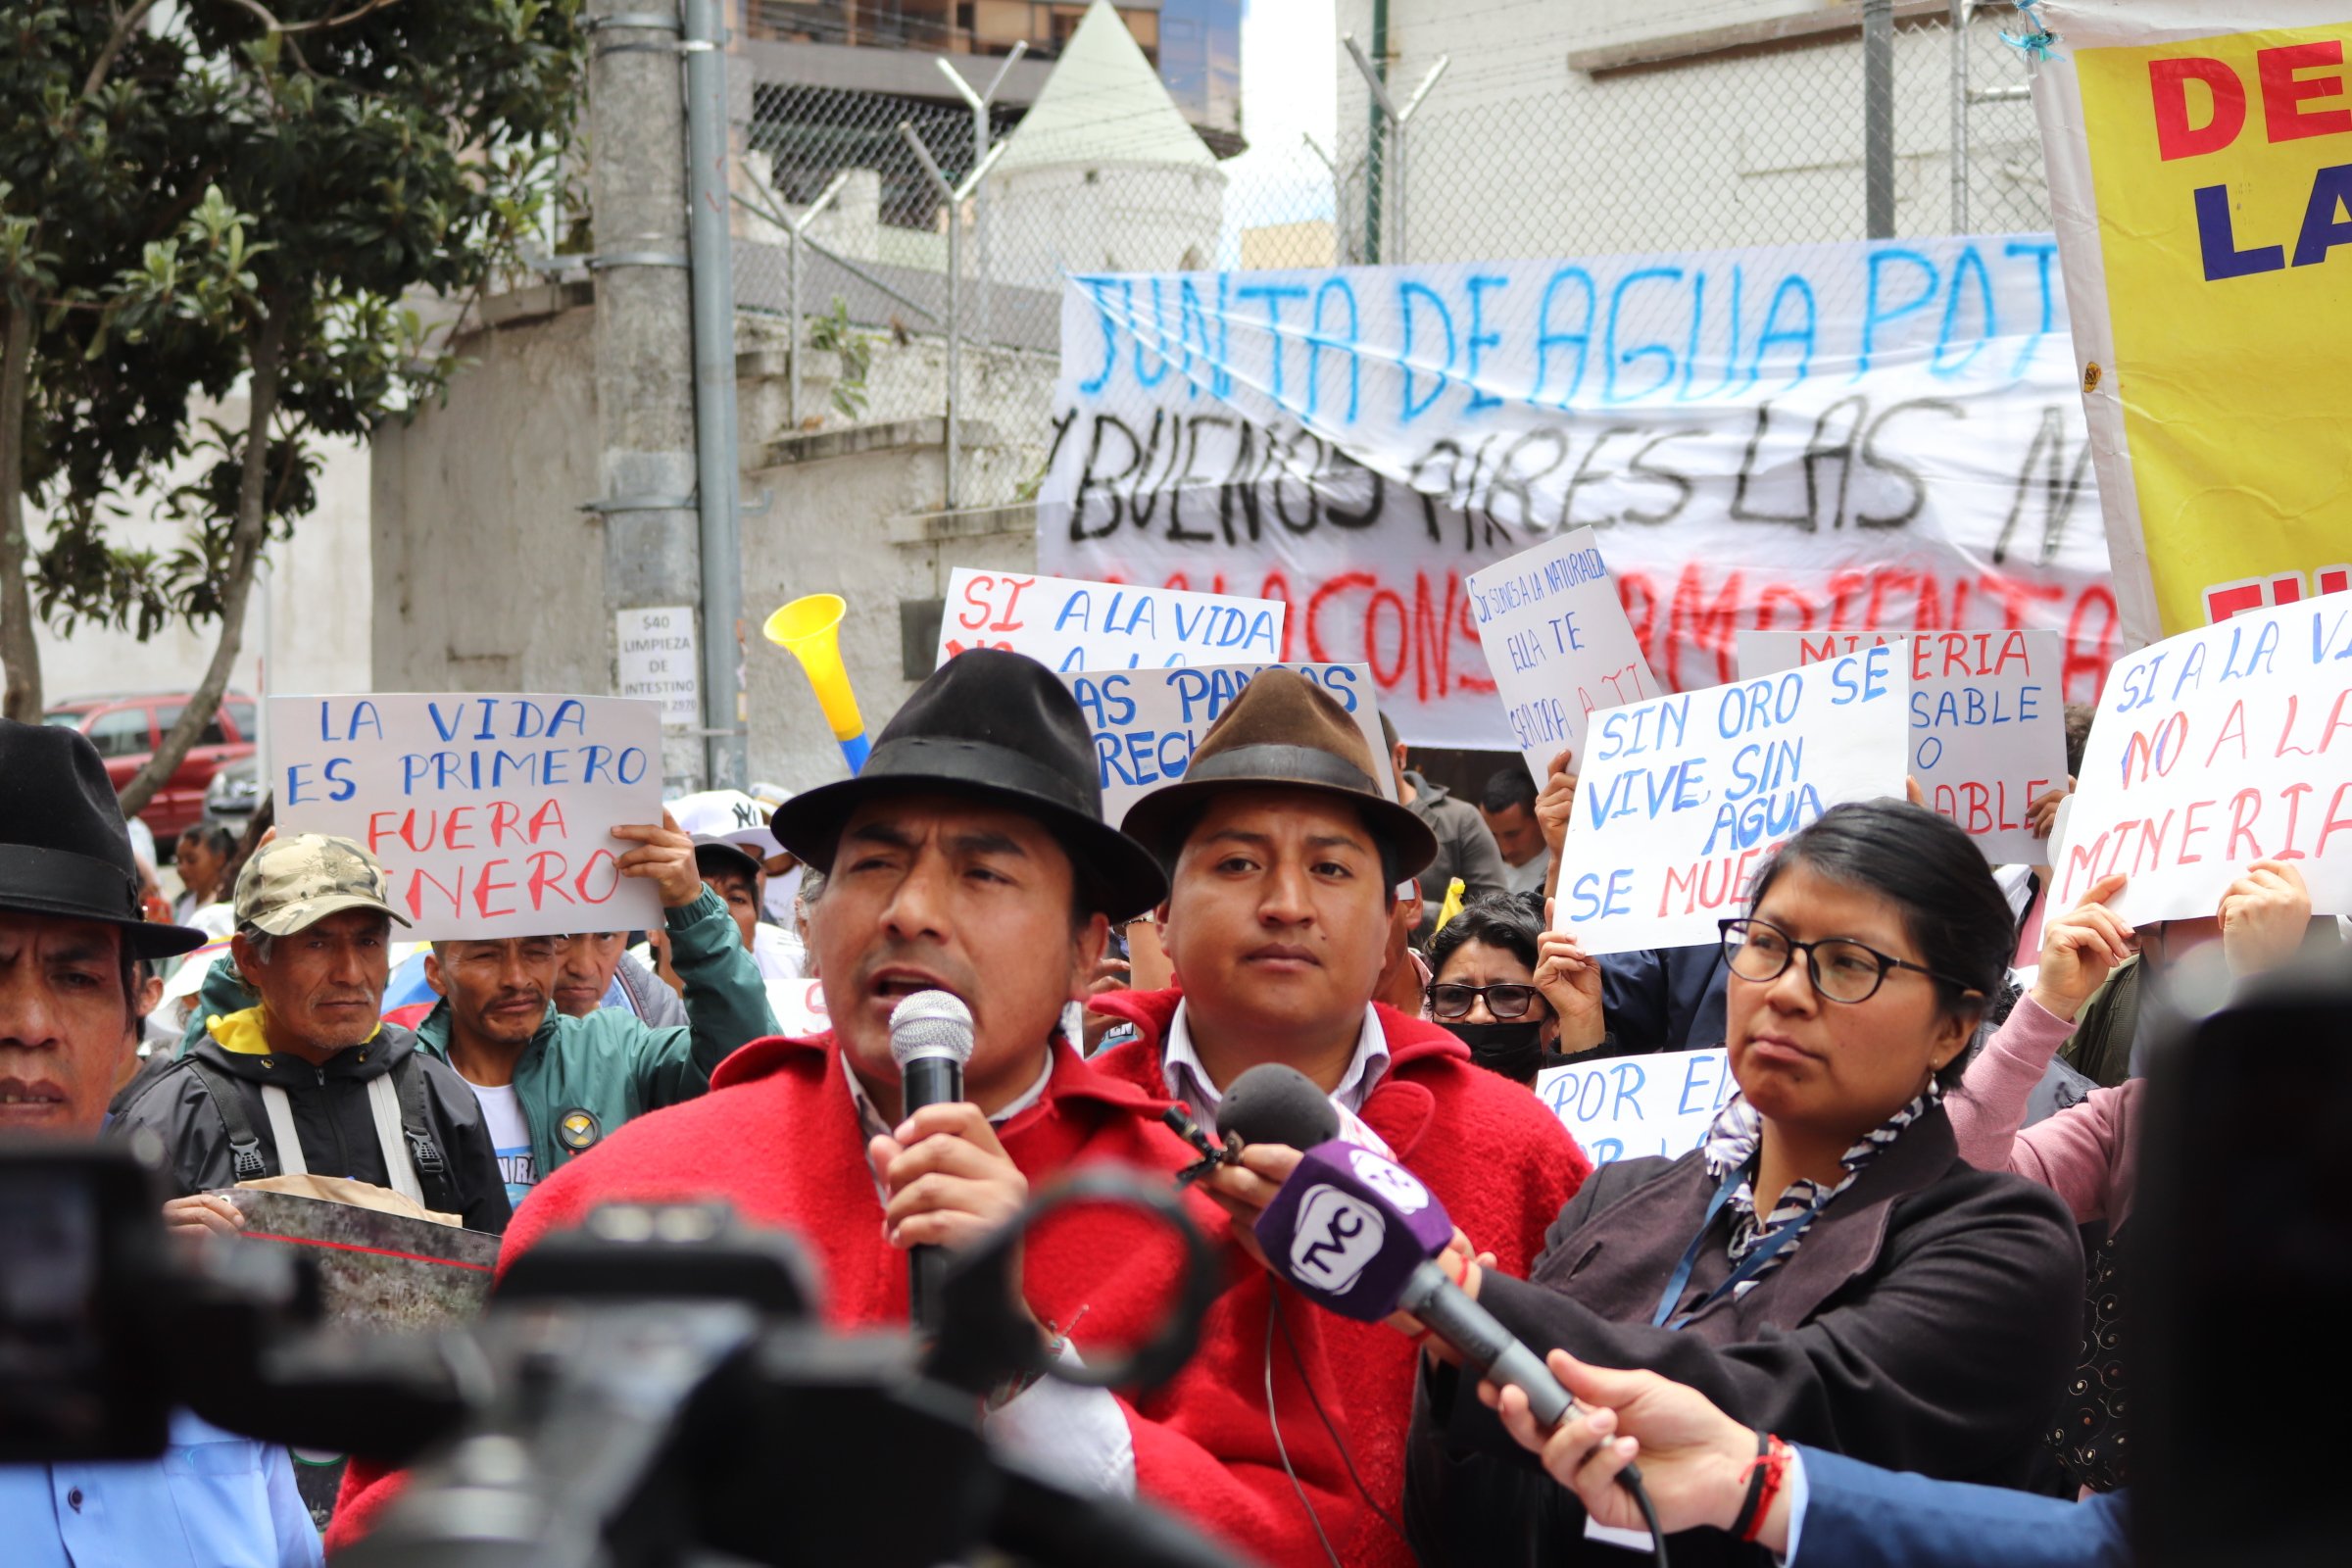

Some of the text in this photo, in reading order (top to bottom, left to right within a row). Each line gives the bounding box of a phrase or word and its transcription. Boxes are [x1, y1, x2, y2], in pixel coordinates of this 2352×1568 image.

[1076, 272, 1358, 423] JUNTA
[1399, 274, 1509, 421] DE
[1530, 267, 1817, 413] AGUA
[1069, 406, 1384, 546] BUENOS
[1407, 423, 1711, 551] AIRES
[1729, 394, 1966, 533] LAS
[958, 575, 1036, 632] SI
[1054, 590, 1091, 632] A
[1102, 591, 1156, 640] LA
[1175, 602, 1275, 655] VIDA
[1470, 576, 1493, 623] SI
[1519, 576, 1531, 607] A
[1529, 571, 1545, 601] LA
[624, 636, 691, 654] LIMPIEZA
[649, 660, 669, 673] DE
[1507, 612, 1585, 674] ELLA TE
[1801, 630, 2030, 681] MERIA
[2116, 651, 2170, 713] SI
[2172, 641, 2207, 703] A
[2220, 619, 2280, 683] LA
[319, 698, 586, 742] LA VIDA
[625, 679, 695, 696] INTESTINO
[1598, 647, 1891, 761] SIN ORO SE
[1725, 736, 1804, 802] SIN
[2121, 688, 2352, 790] NO A LA
[287, 745, 647, 807] ES PRIMERO
[368, 799, 567, 857] FUERA
[1701, 782, 1827, 857] AGUA
[2061, 781, 2352, 905] MINERIA
[383, 849, 620, 921] NERO
[1570, 842, 1786, 923] SE MUE
[1544, 1062, 1645, 1123] POR
[1301, 1206, 1363, 1274] TVC
